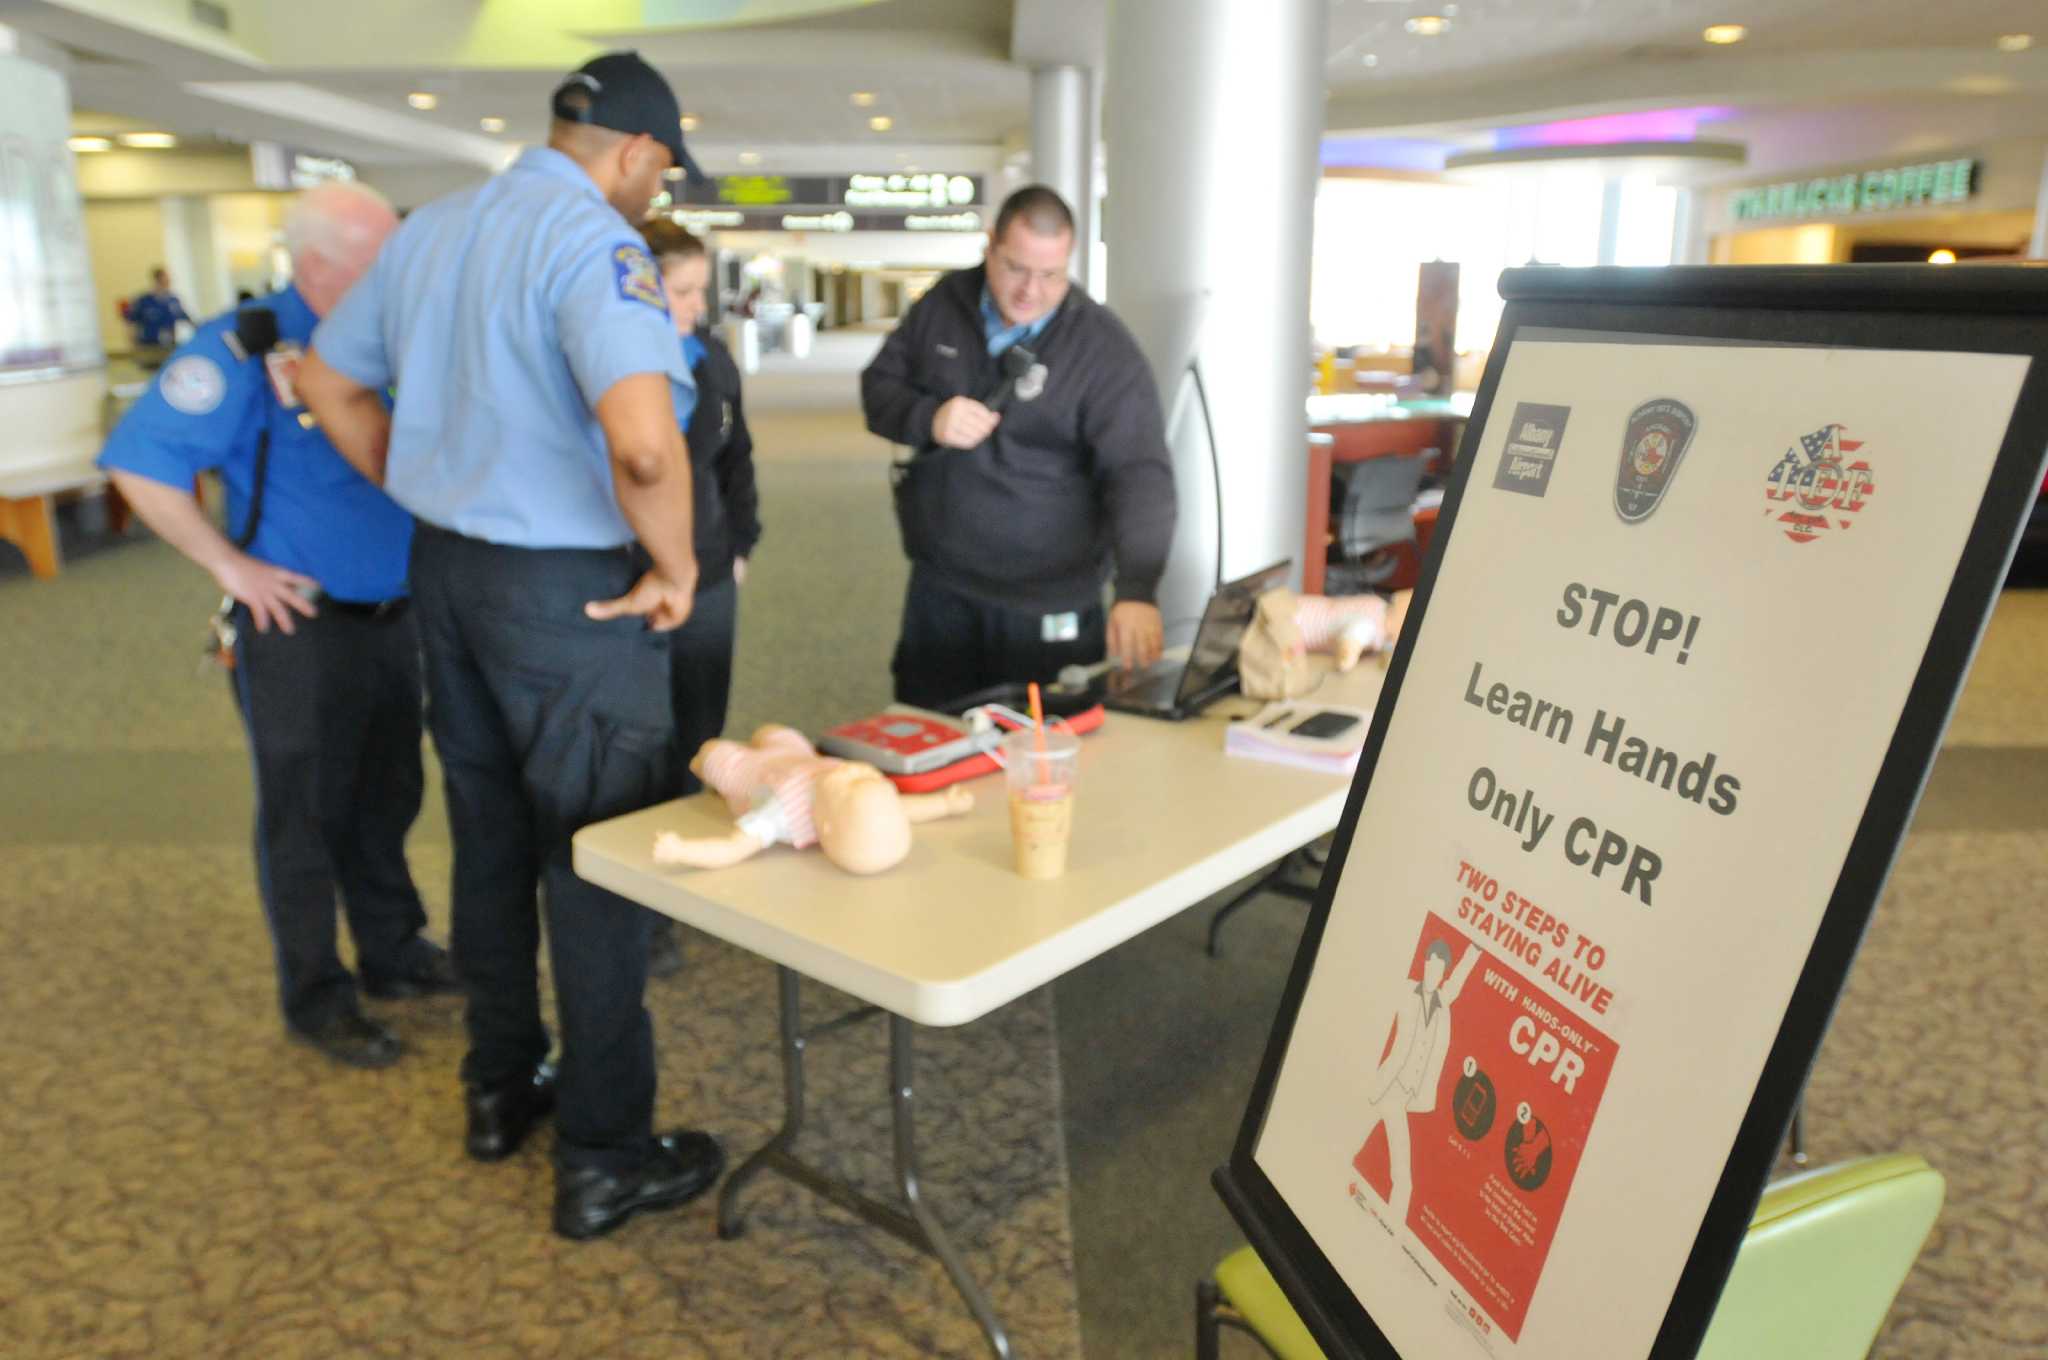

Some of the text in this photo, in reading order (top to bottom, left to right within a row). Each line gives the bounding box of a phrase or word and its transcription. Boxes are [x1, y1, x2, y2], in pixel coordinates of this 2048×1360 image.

[1556, 582, 1701, 665] STOP!
[1464, 662, 1741, 816] Learn Hands
[1467, 767, 1662, 906] Only CPR
[1456, 861, 1606, 970] TWO STEPS TO
[1458, 897, 1614, 1016] STAYING ALIVE
[1483, 968, 1519, 1002] WITH
[1509, 1015, 1585, 1095] CPR
